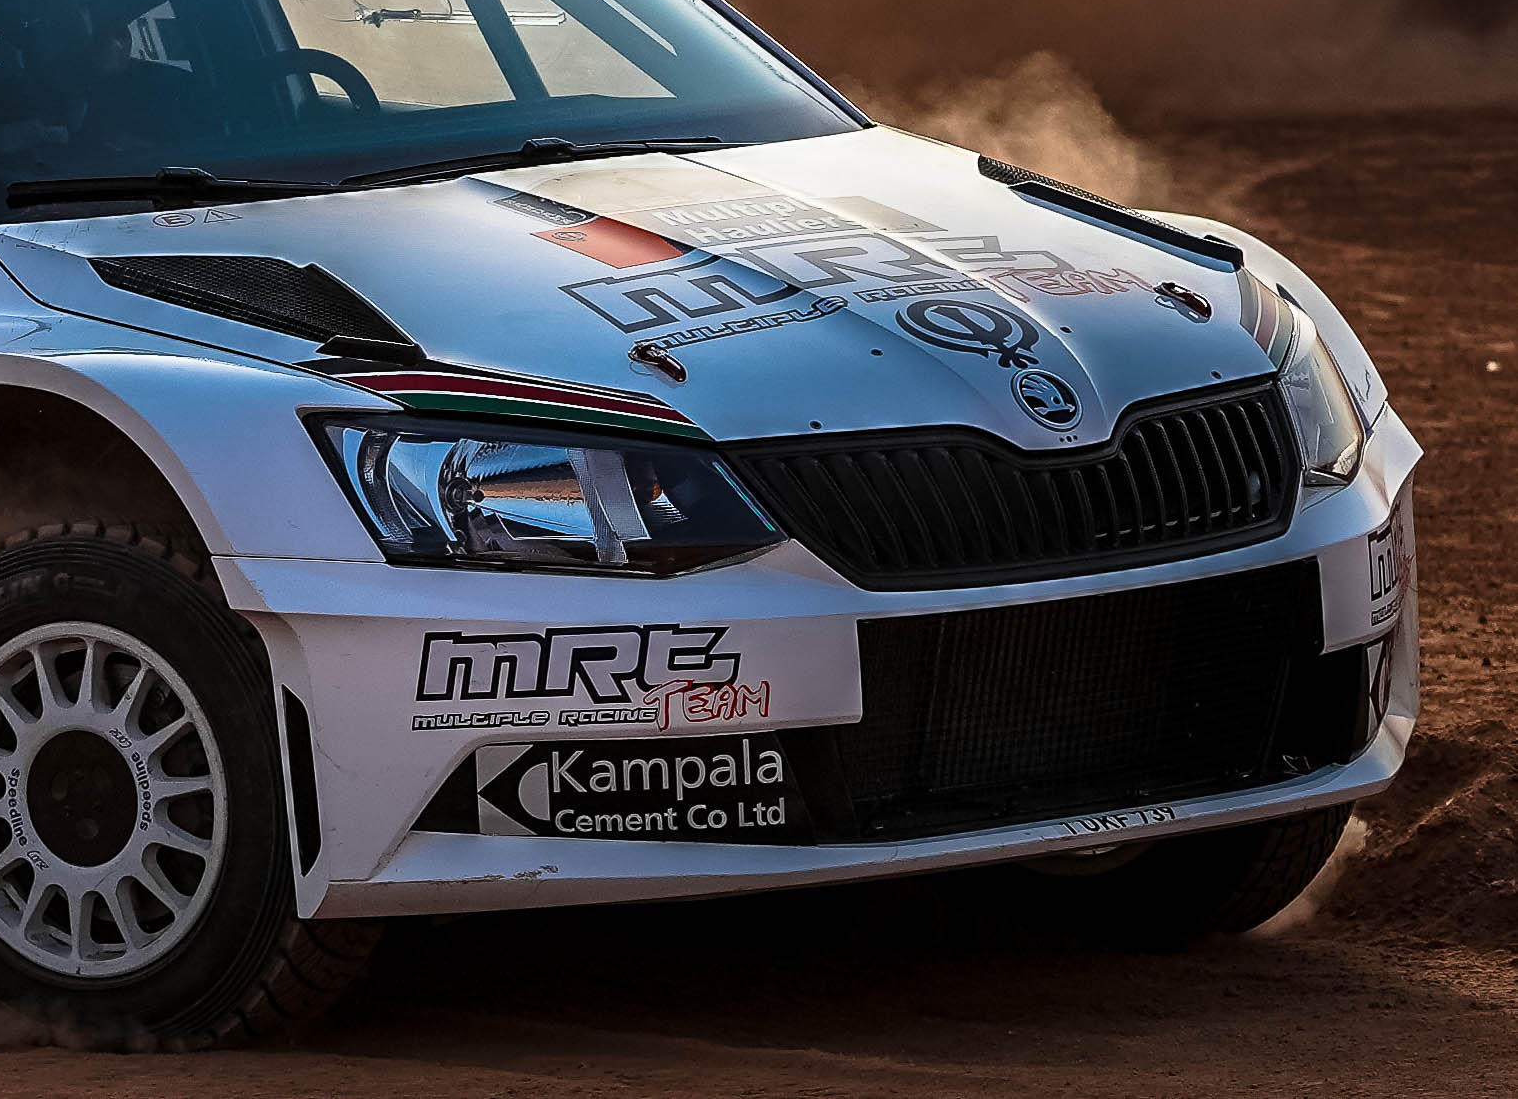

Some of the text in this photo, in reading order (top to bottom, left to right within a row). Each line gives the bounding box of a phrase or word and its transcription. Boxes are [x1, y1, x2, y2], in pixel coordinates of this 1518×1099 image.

[653, 195, 814, 227] Multipl
[643, 679, 770, 731] TEAM
[131, 751, 152, 832] speedline
[552, 739, 784, 801] Kampala
[7, 767, 28, 847] speedline
[554, 796, 787, 834] Cement Co Ltd
[1128, 806, 1176, 825] 739
